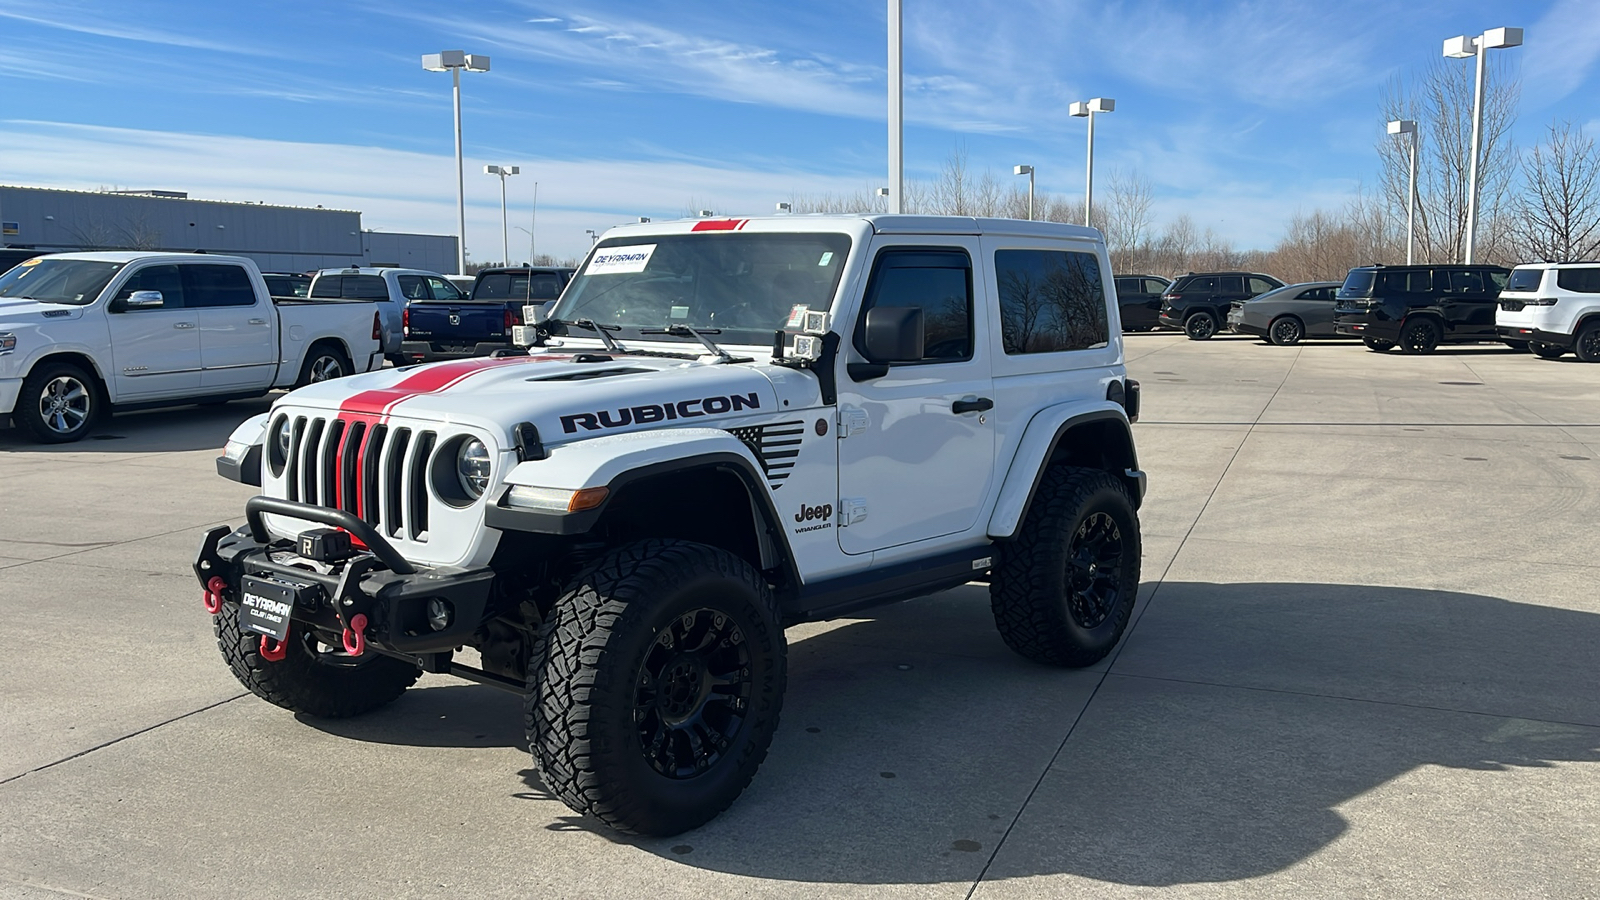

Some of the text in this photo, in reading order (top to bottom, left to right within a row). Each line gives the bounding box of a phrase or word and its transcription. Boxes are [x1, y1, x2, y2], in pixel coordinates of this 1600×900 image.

[594, 253, 648, 263] DEYARMAN
[559, 392, 761, 434] RUBICON
[795, 503, 832, 523] Jeep
[795, 522, 832, 534] WRANGLER
[302, 538, 312, 556] R
[242, 592, 291, 617] DEYARMAN
